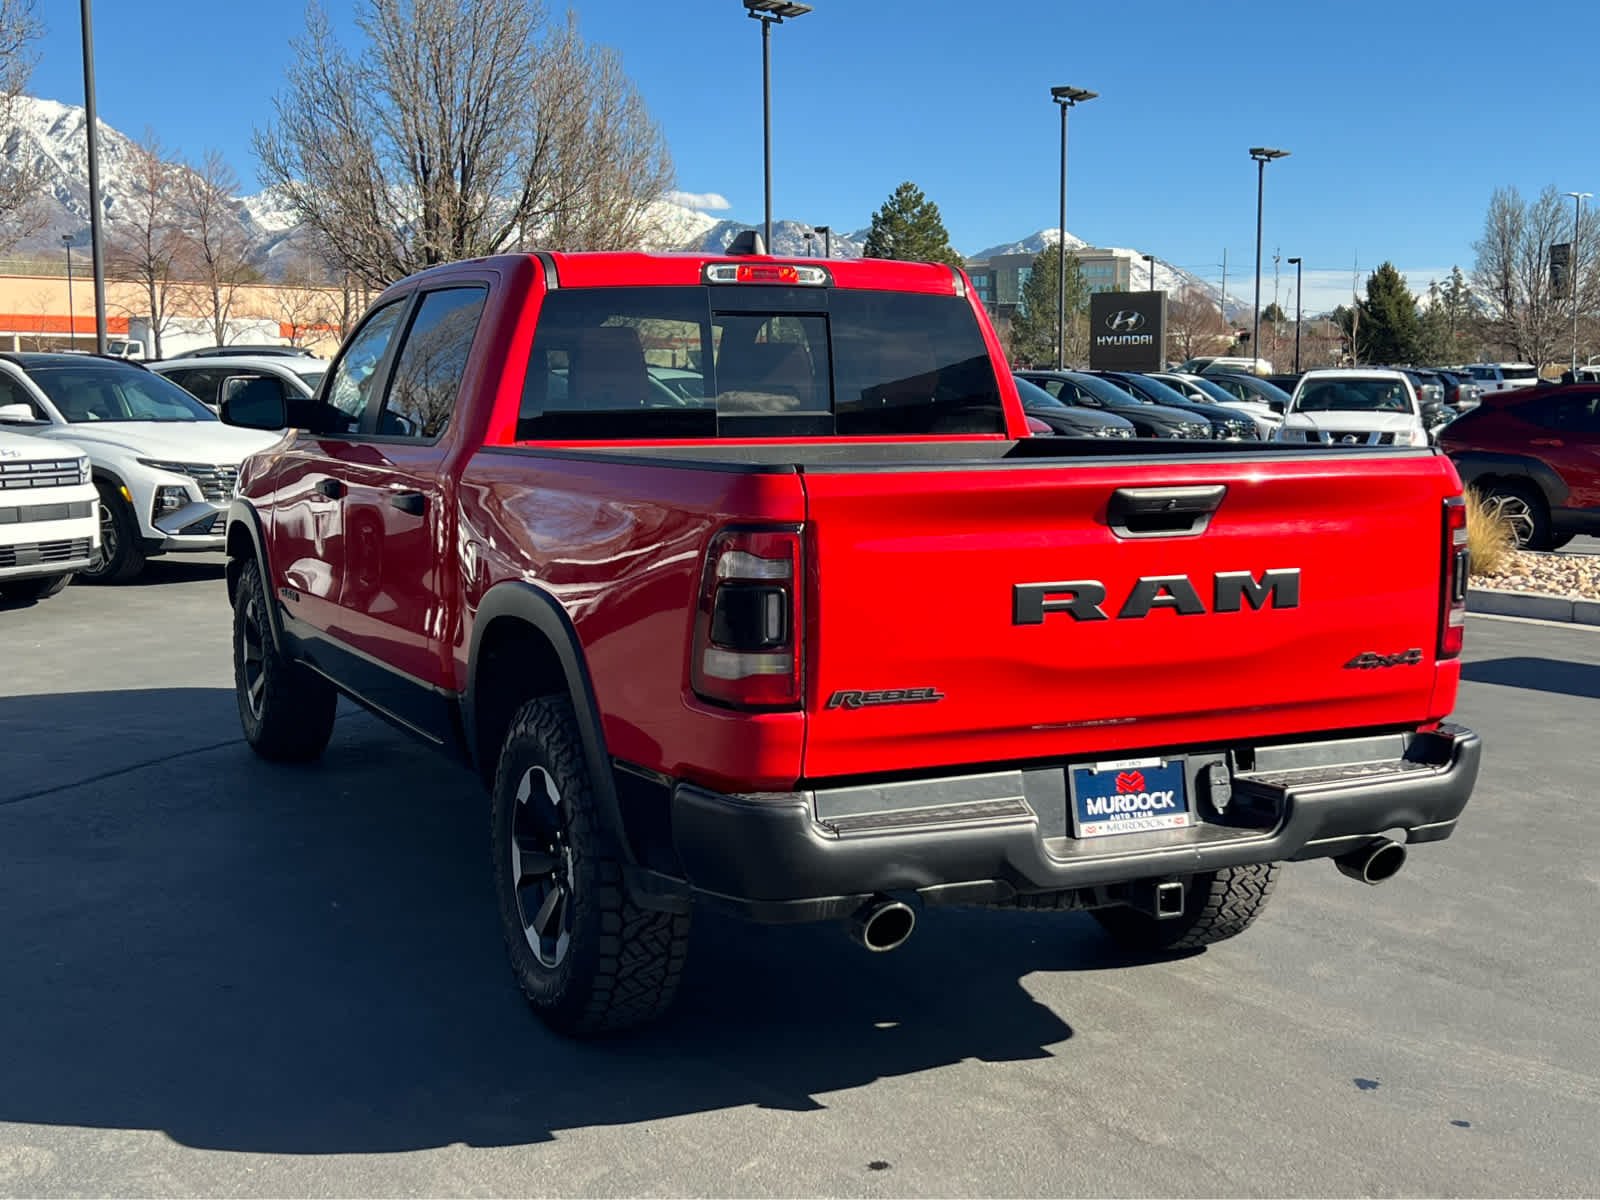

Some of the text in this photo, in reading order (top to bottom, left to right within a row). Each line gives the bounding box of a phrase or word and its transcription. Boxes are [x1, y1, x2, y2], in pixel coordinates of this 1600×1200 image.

[1096, 334, 1153, 346] HYUNDAI
[1011, 567, 1301, 626] RAM
[1343, 647, 1424, 671] 4x4
[826, 686, 945, 710] REBEL
[1086, 790, 1176, 816] MURDOCK
[1106, 818, 1165, 833] MURDOCK
[1110, 810, 1154, 821] AUTO TEAM
